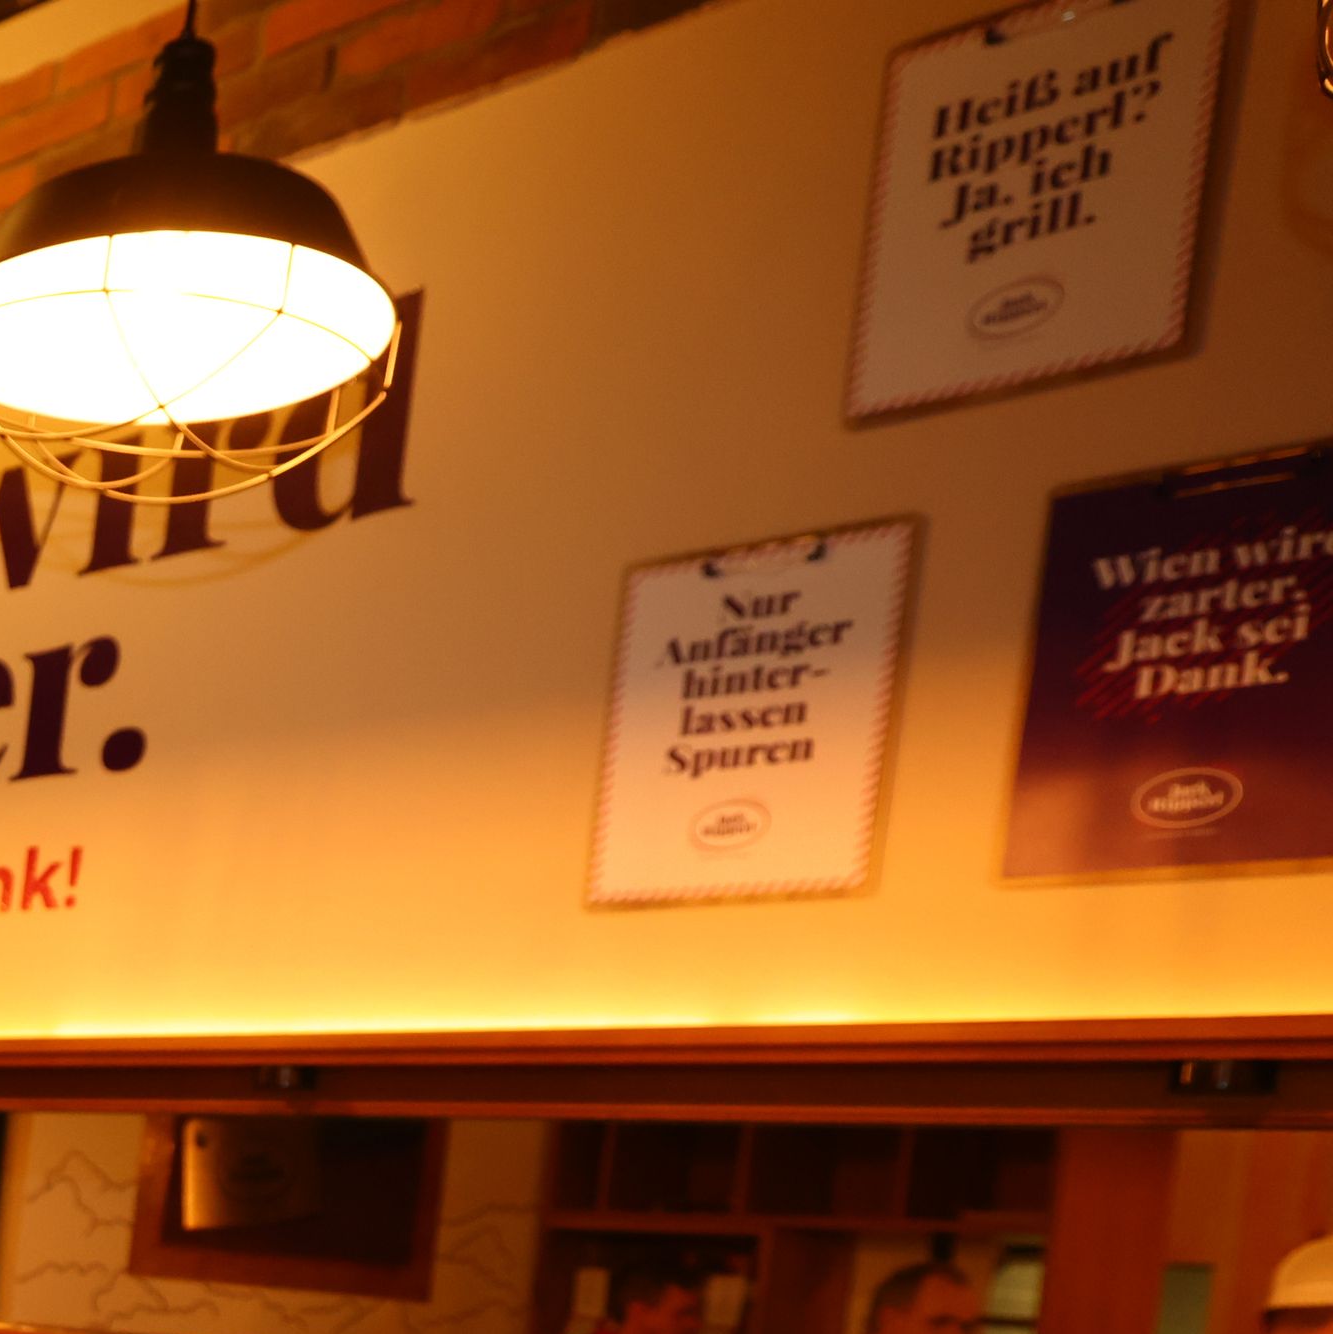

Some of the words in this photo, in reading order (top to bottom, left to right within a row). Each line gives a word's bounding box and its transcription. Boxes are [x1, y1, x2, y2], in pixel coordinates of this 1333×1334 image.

[934, 69, 1060, 139] Heiß
[1072, 31, 1174, 97] auf
[929, 80, 1161, 183] Ripperl?
[1030, 144, 1112, 196] ich
[965, 190, 1097, 265] grill.
[1092, 546, 1222, 591] Wien
[719, 589, 802, 623] Nur
[1139, 575, 1308, 624] zarter.
[655, 620, 854, 669] Anfänger
[1102, 616, 1225, 674] Jack
[1236, 602, 1313, 650] sei
[682, 664, 829, 700] hinter-
[1135, 650, 1290, 700] Dank.
[681, 701, 808, 737] lassen
[664, 737, 815, 780] Spuren
